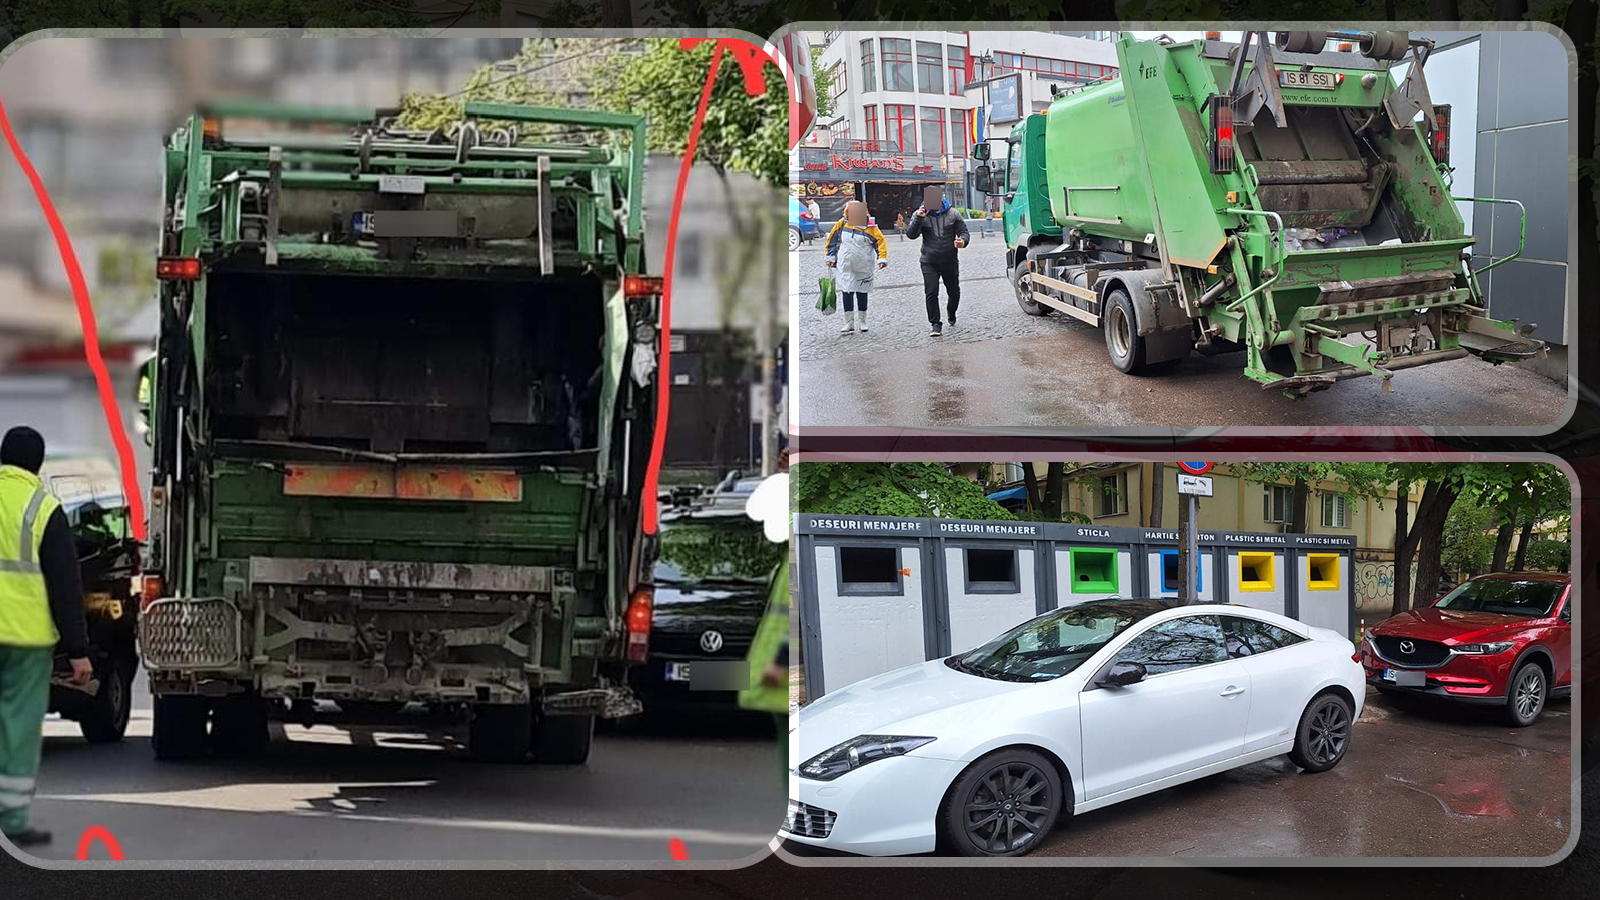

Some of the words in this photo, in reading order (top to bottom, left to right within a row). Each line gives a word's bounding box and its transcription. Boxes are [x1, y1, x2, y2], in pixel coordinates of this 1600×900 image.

[1145, 66, 1157, 80] EFE
[1287, 72, 1296, 84] IS
[1299, 73, 1308, 84] 81
[1312, 74, 1329, 86] SSI
[810, 519, 860, 530] DESEURI
[863, 520, 921, 531] MENAJERE
[940, 523, 984, 533] DESEURI
[986, 525, 1036, 535] MENAJERE
[1077, 528, 1110, 538] STICLA
[1145, 531, 1174, 540] HARTIE
[1225, 535, 1254, 543] PLASTIC
